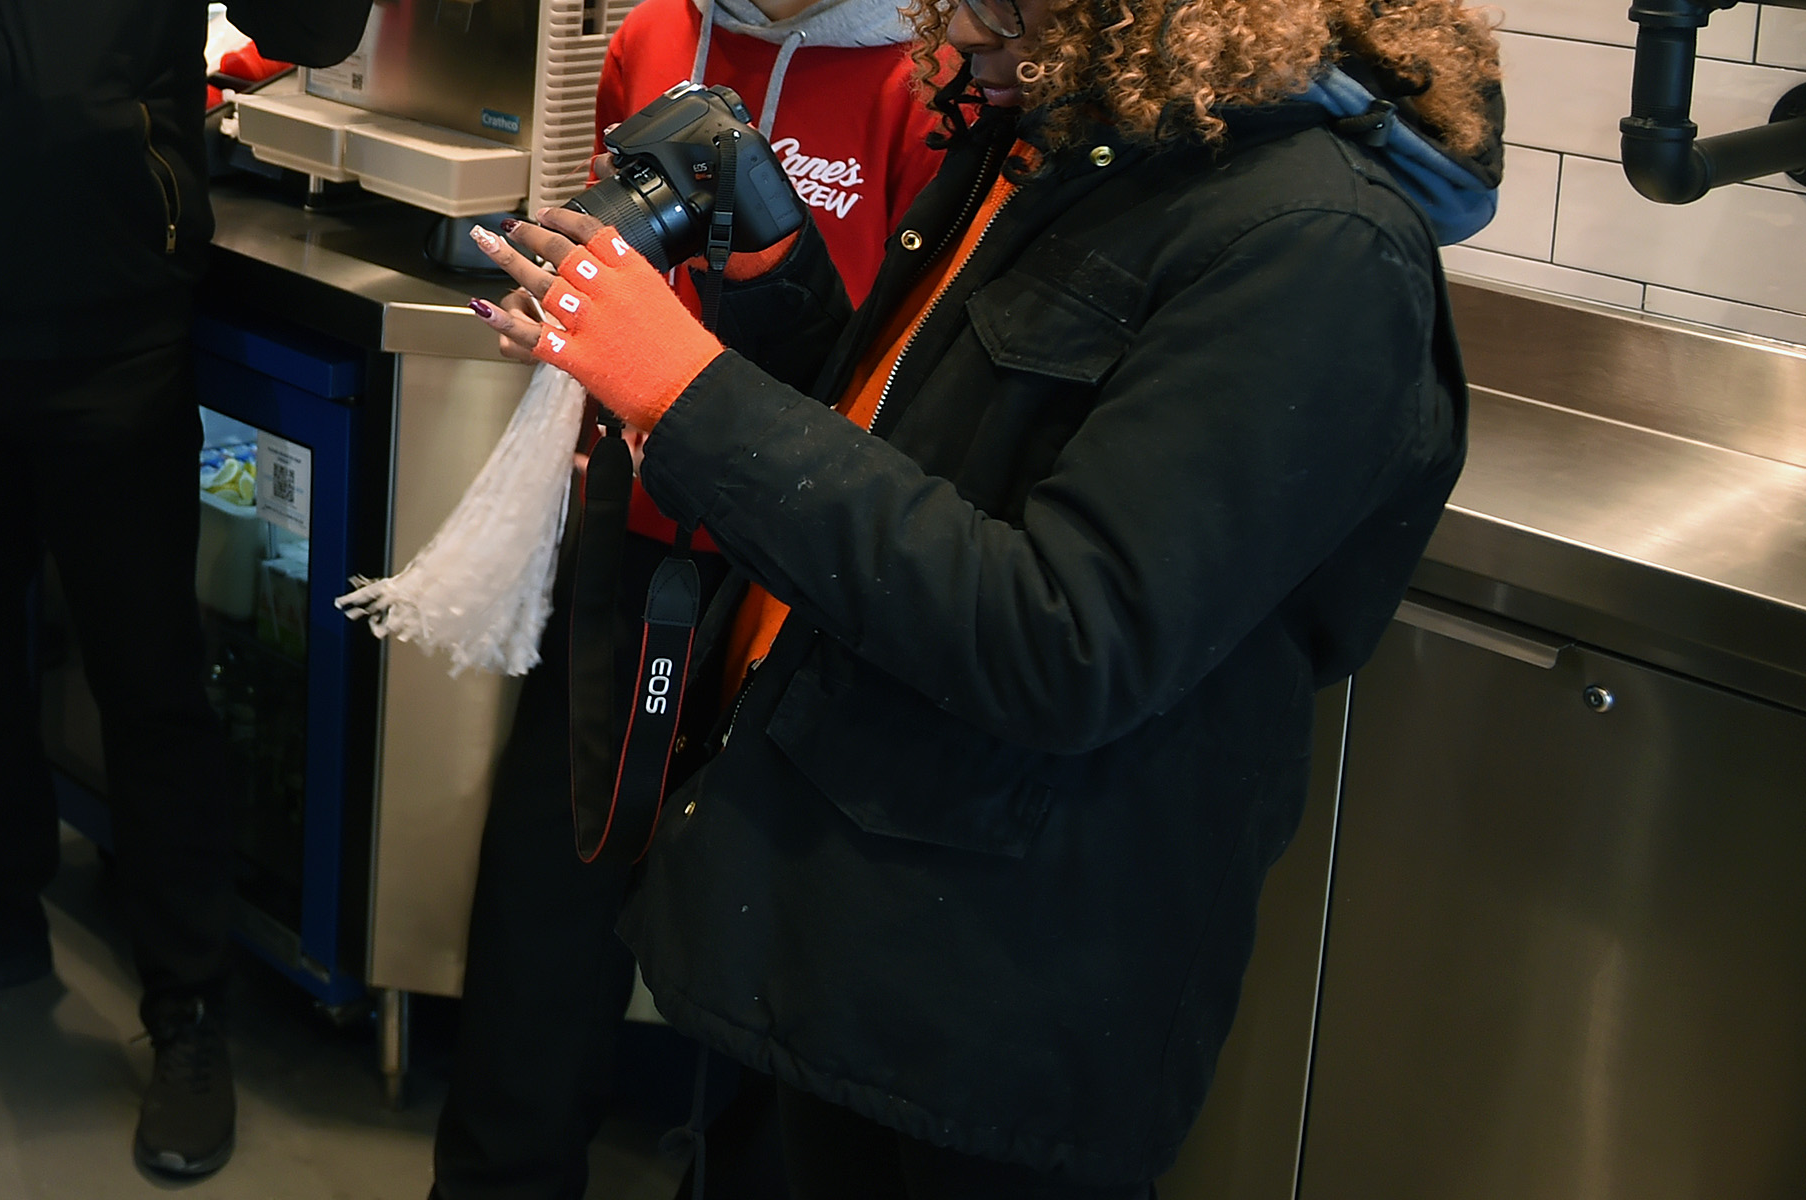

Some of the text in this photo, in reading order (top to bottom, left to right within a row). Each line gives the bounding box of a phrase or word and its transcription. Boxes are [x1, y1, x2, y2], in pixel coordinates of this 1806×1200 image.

[771, 137, 864, 187] Cane's
[792, 177, 858, 220] REW
[645, 657, 673, 715] EOS
